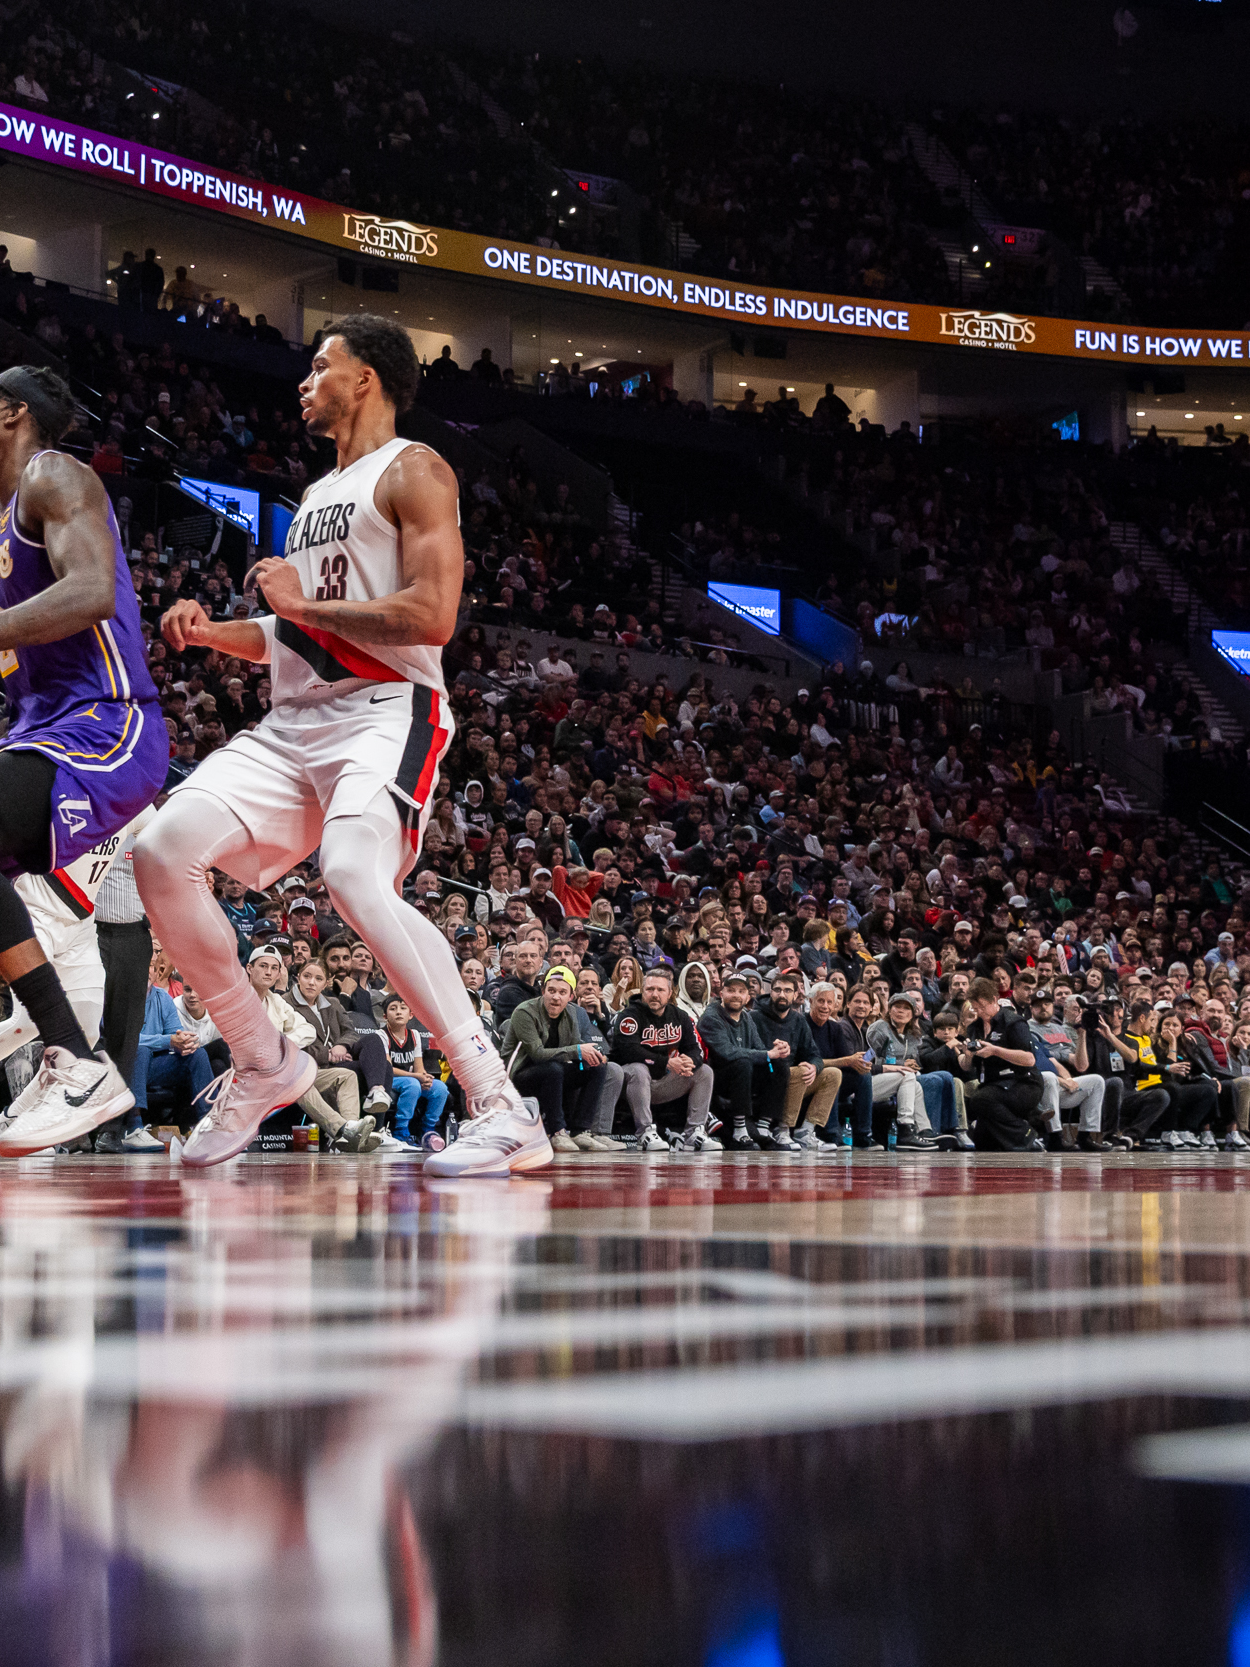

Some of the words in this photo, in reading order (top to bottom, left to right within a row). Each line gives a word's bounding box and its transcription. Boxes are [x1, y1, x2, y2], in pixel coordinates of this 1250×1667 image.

[41, 125, 76, 158] WE
[81, 137, 135, 176] ROLL
[151, 158, 268, 217] TOPPENISH,
[272, 194, 306, 226] WA
[342, 213, 438, 257] LEGENDS
[359, 244, 386, 259] CASINO
[393, 252, 418, 264] HOTEL
[483, 246, 531, 274] ONE
[535, 254, 678, 304] DESTINATION,
[683, 282, 767, 316] ENDLESS
[773, 297, 910, 332] INDULGENCE
[939, 310, 1036, 344] LEGENDS
[959, 338, 987, 349] CASINO
[994, 341, 1017, 351] HOTEL
[1074, 329, 1117, 354] FUN
[1122, 333, 1140, 354] IS
[1145, 336, 1204, 358] HOW
[1208, 339, 1243, 359] WE
[315, 553, 349, 600] 33
[57, 794, 93, 838] LA
[87, 836, 120, 856] ERS
[87, 860, 110, 884] 17
[261, 1142, 286, 1150] CASINO
